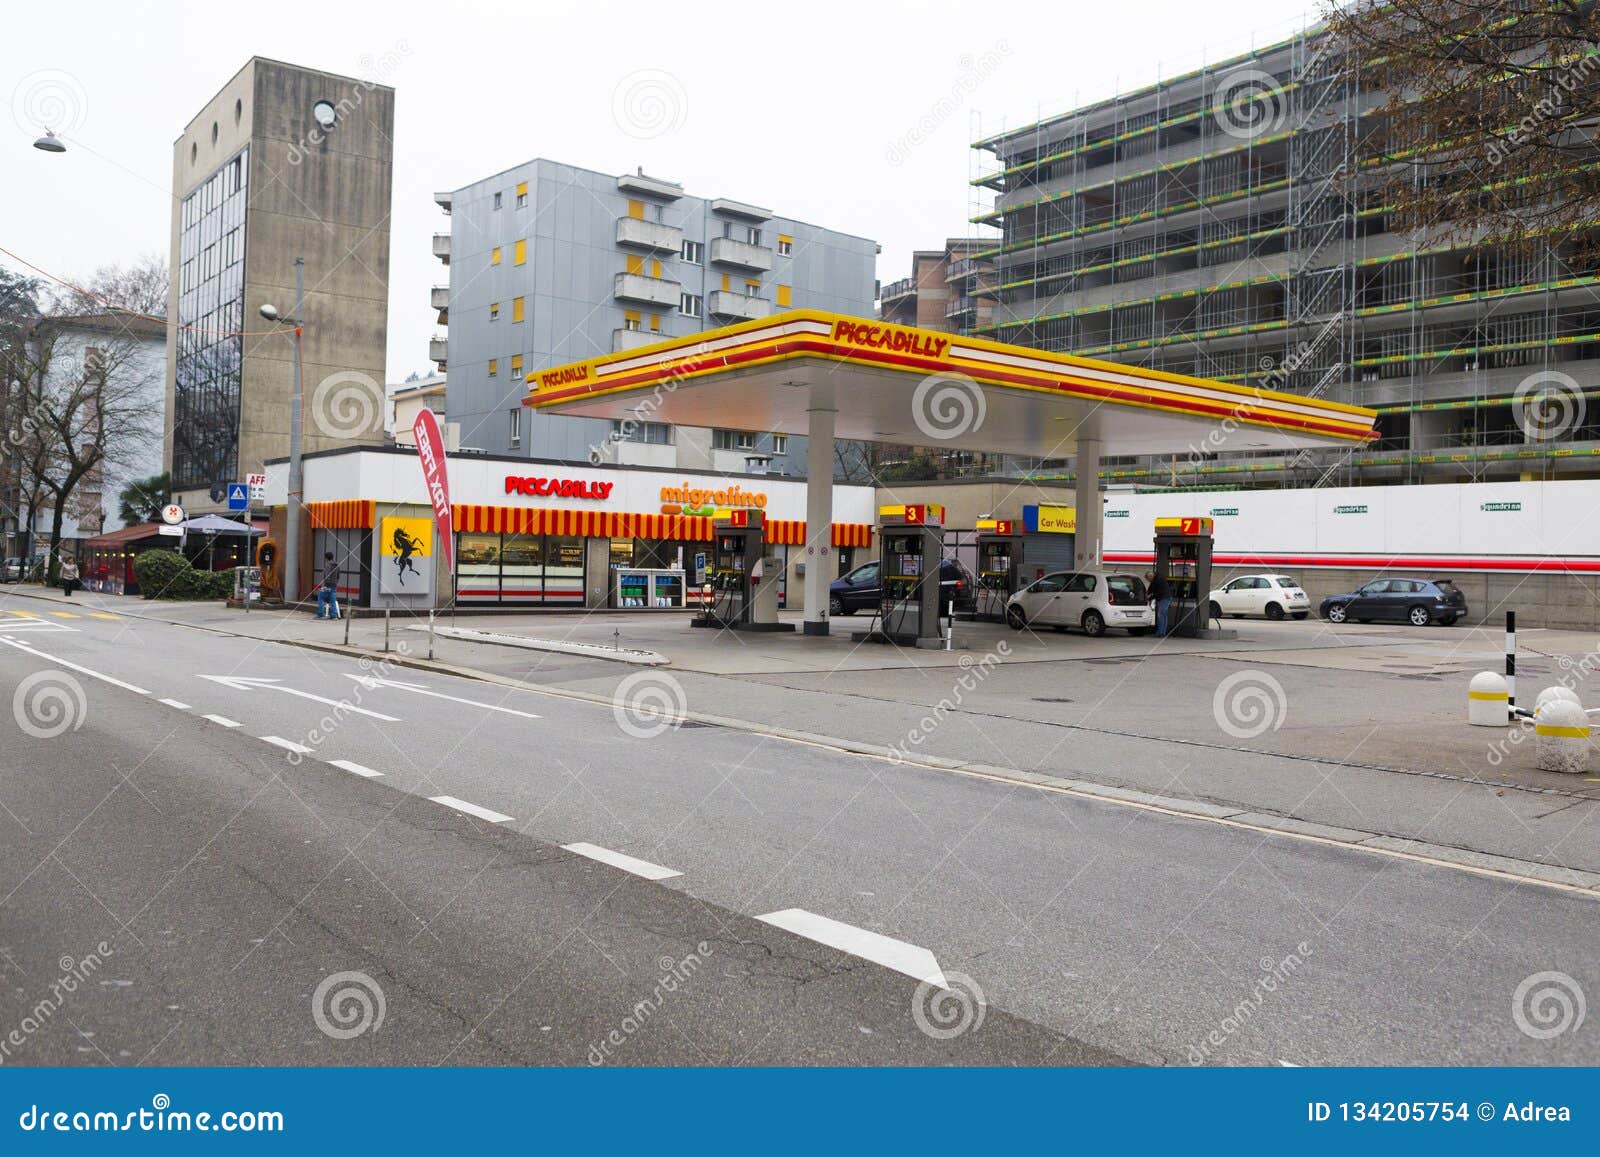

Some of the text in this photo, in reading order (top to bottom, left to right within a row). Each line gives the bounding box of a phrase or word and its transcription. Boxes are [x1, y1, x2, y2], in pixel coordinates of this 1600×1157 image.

[661, 481, 767, 509] migrolino
[733, 512, 738, 523] 1
[908, 507, 916, 521] 3
[999, 523, 1005, 533] 5
[1041, 518, 1076, 529] Car Wash
[1183, 520, 1192, 532] 7
